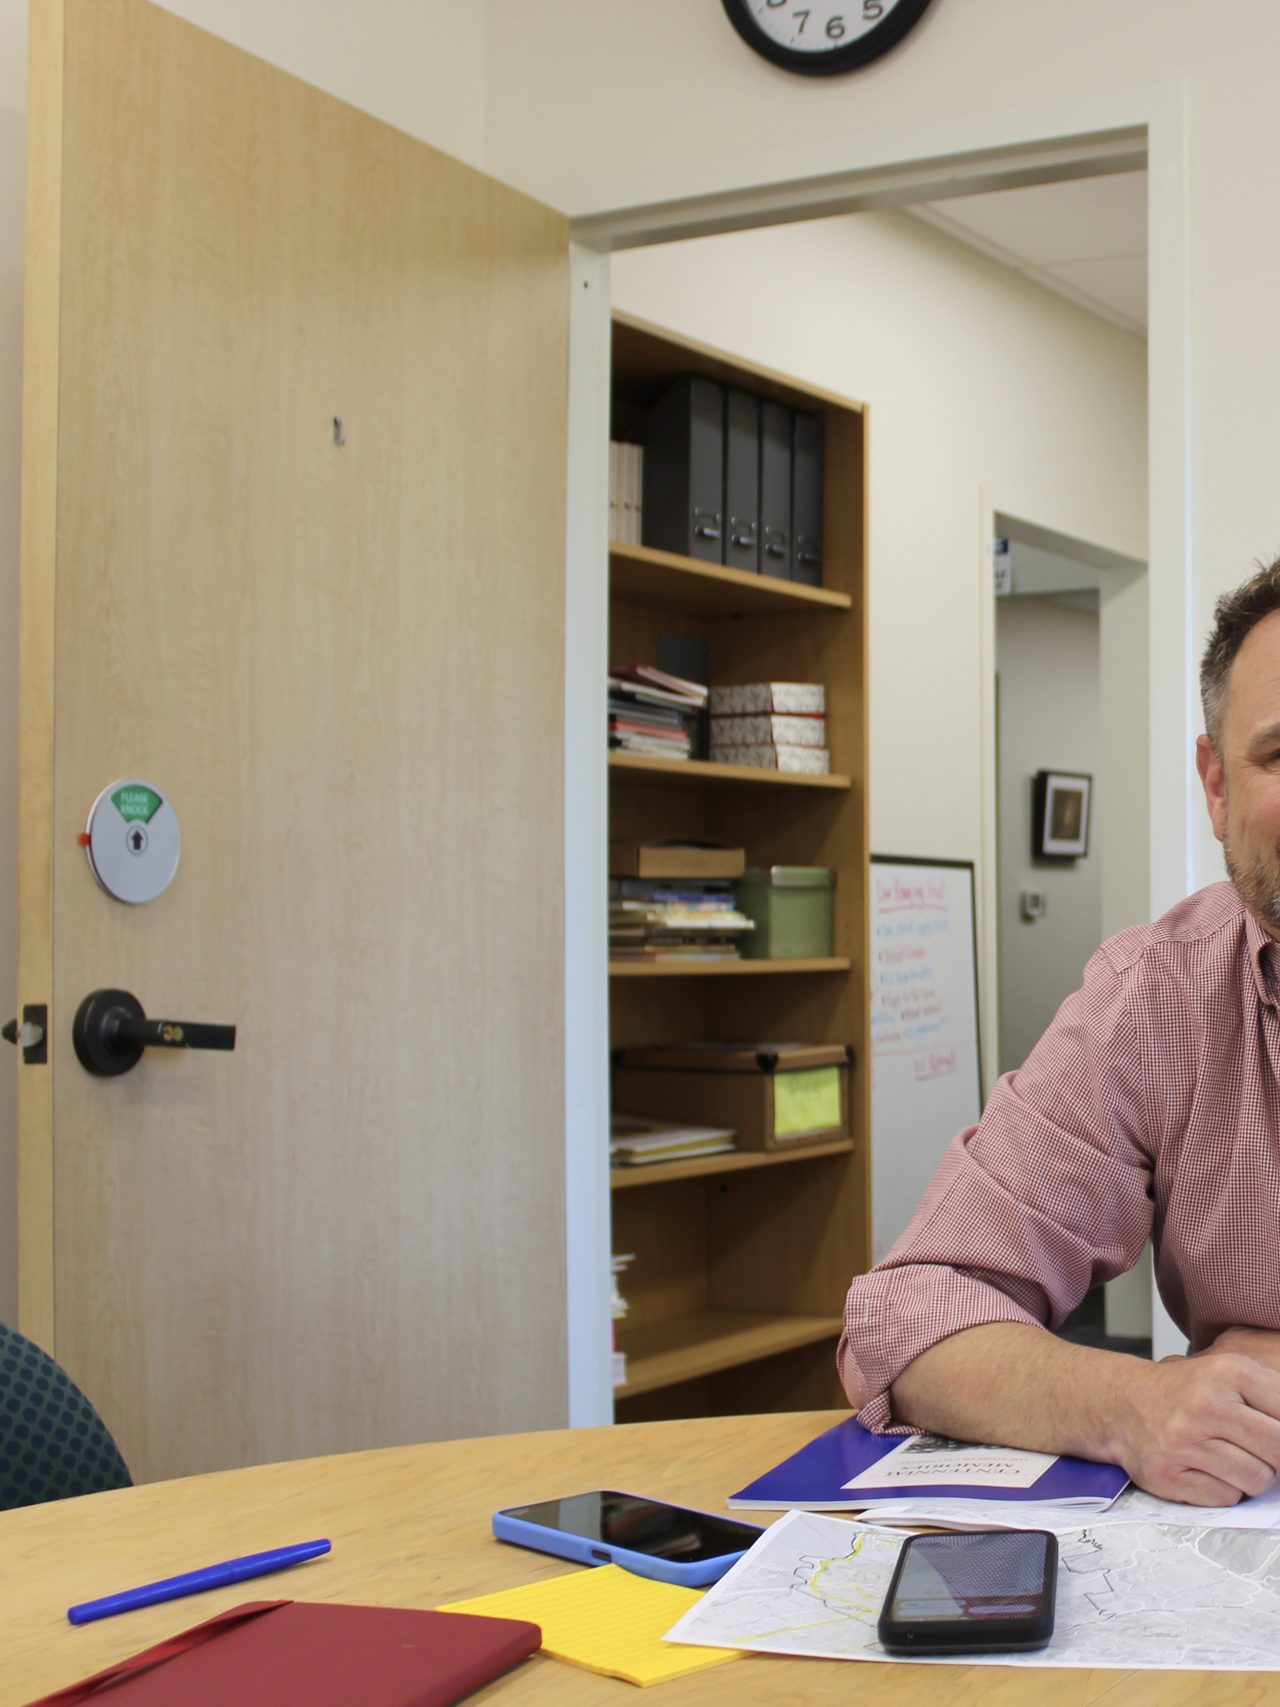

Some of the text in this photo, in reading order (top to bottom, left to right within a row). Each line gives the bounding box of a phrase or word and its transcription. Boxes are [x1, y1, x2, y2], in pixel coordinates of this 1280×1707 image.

[792, 9, 810, 34] 7
[863, 0, 883, 20] 5
[825, 15, 846, 39] 6
